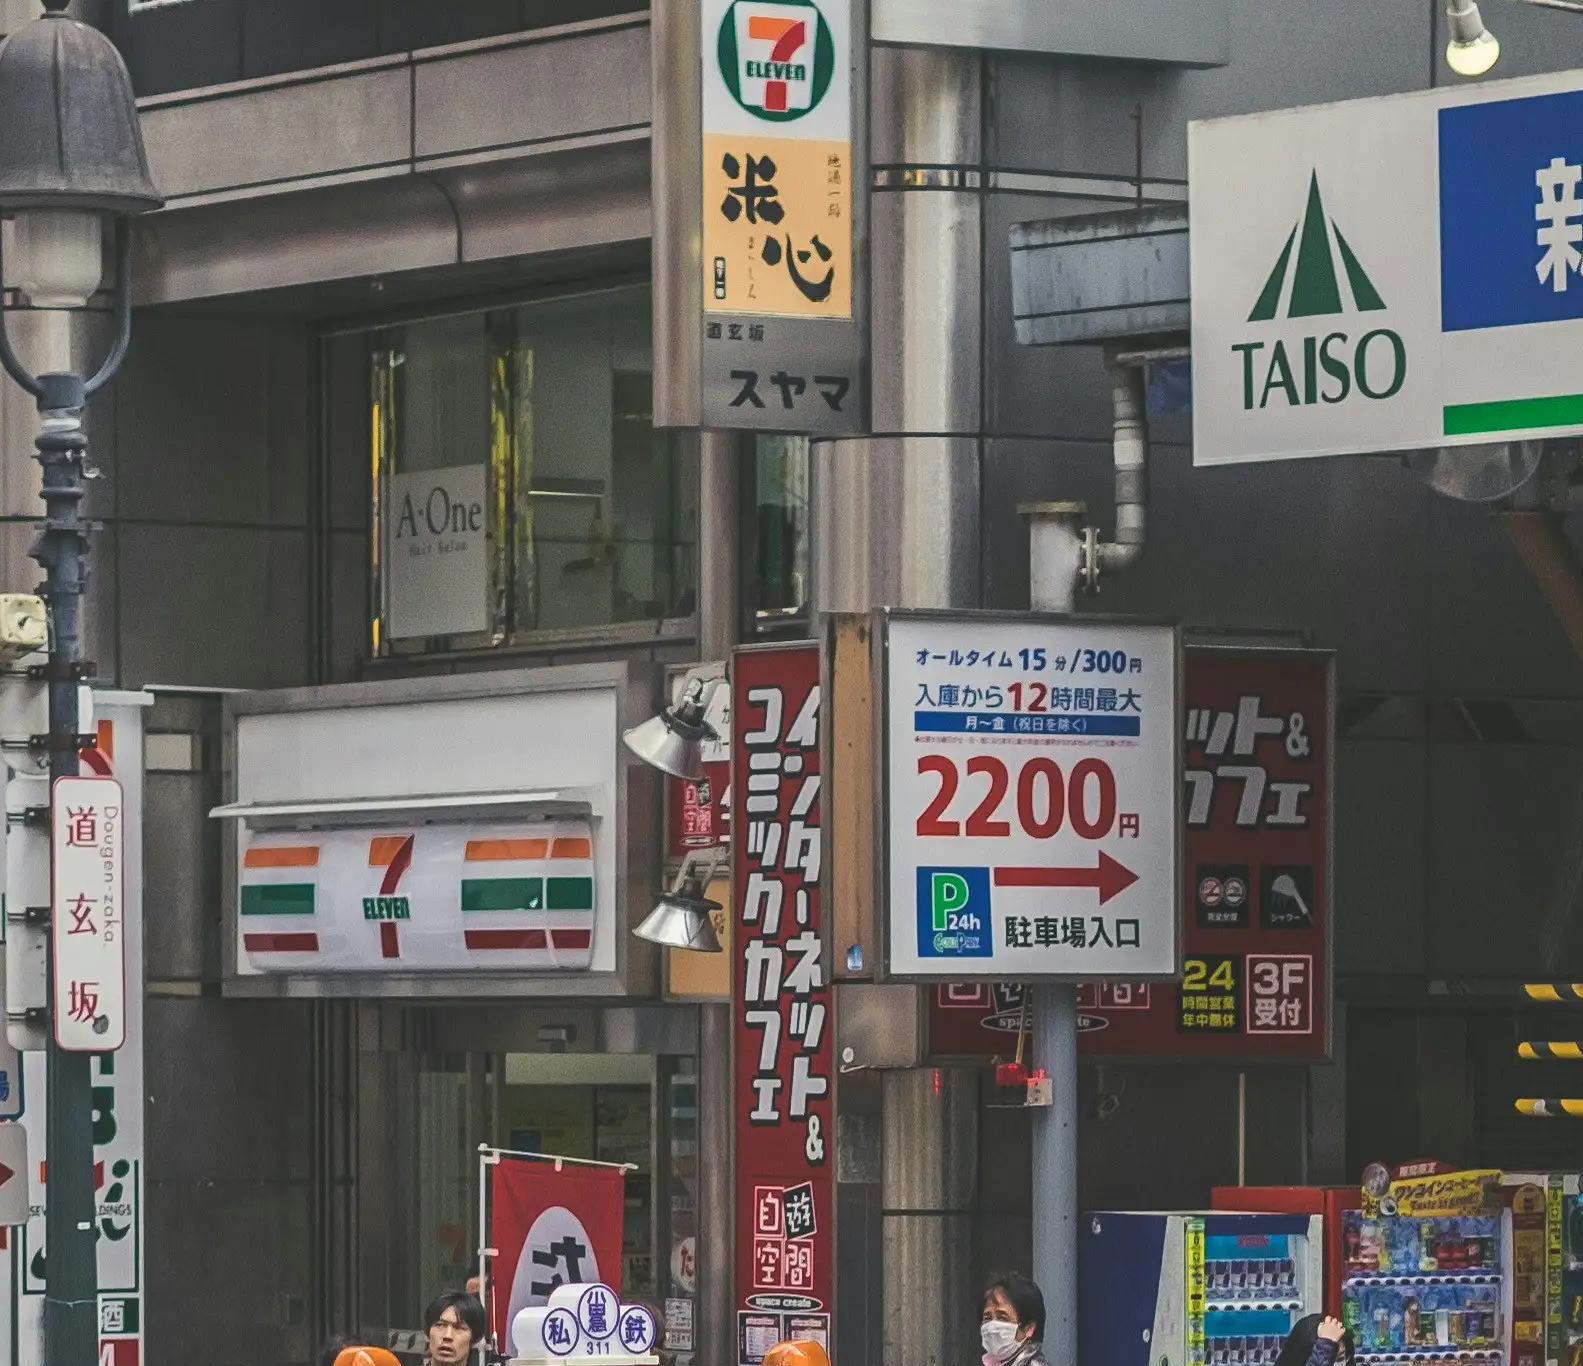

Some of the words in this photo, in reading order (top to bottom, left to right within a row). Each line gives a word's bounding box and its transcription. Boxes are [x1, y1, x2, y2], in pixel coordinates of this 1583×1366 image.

[746, 60, 806, 81] ELEVEN
[706, 322, 764, 342] 道玄坂
[1232, 329, 1407, 411] TAISO
[729, 370, 850, 412] スヤマ
[917, 648, 1013, 668] オールタイム
[915, 681, 1142, 712] 入庫から12時間最大
[65, 804, 100, 1024] 道玄坂
[362, 896, 410, 921] ELEVEN
[744, 688, 783, 1122] コミックカフェ
[932, 873, 969, 930] P
[949, 913, 981, 931] 24h
[1005, 916, 1141, 949] 駐車場入口
[1182, 960, 1235, 992] 24
[1254, 962, 1305, 996] 3F
[1254, 998, 1302, 1028] 受付
[548, 1317, 571, 1345] 私
[624, 1315, 647, 1344] 鉄
[587, 1341, 611, 1355] 311
